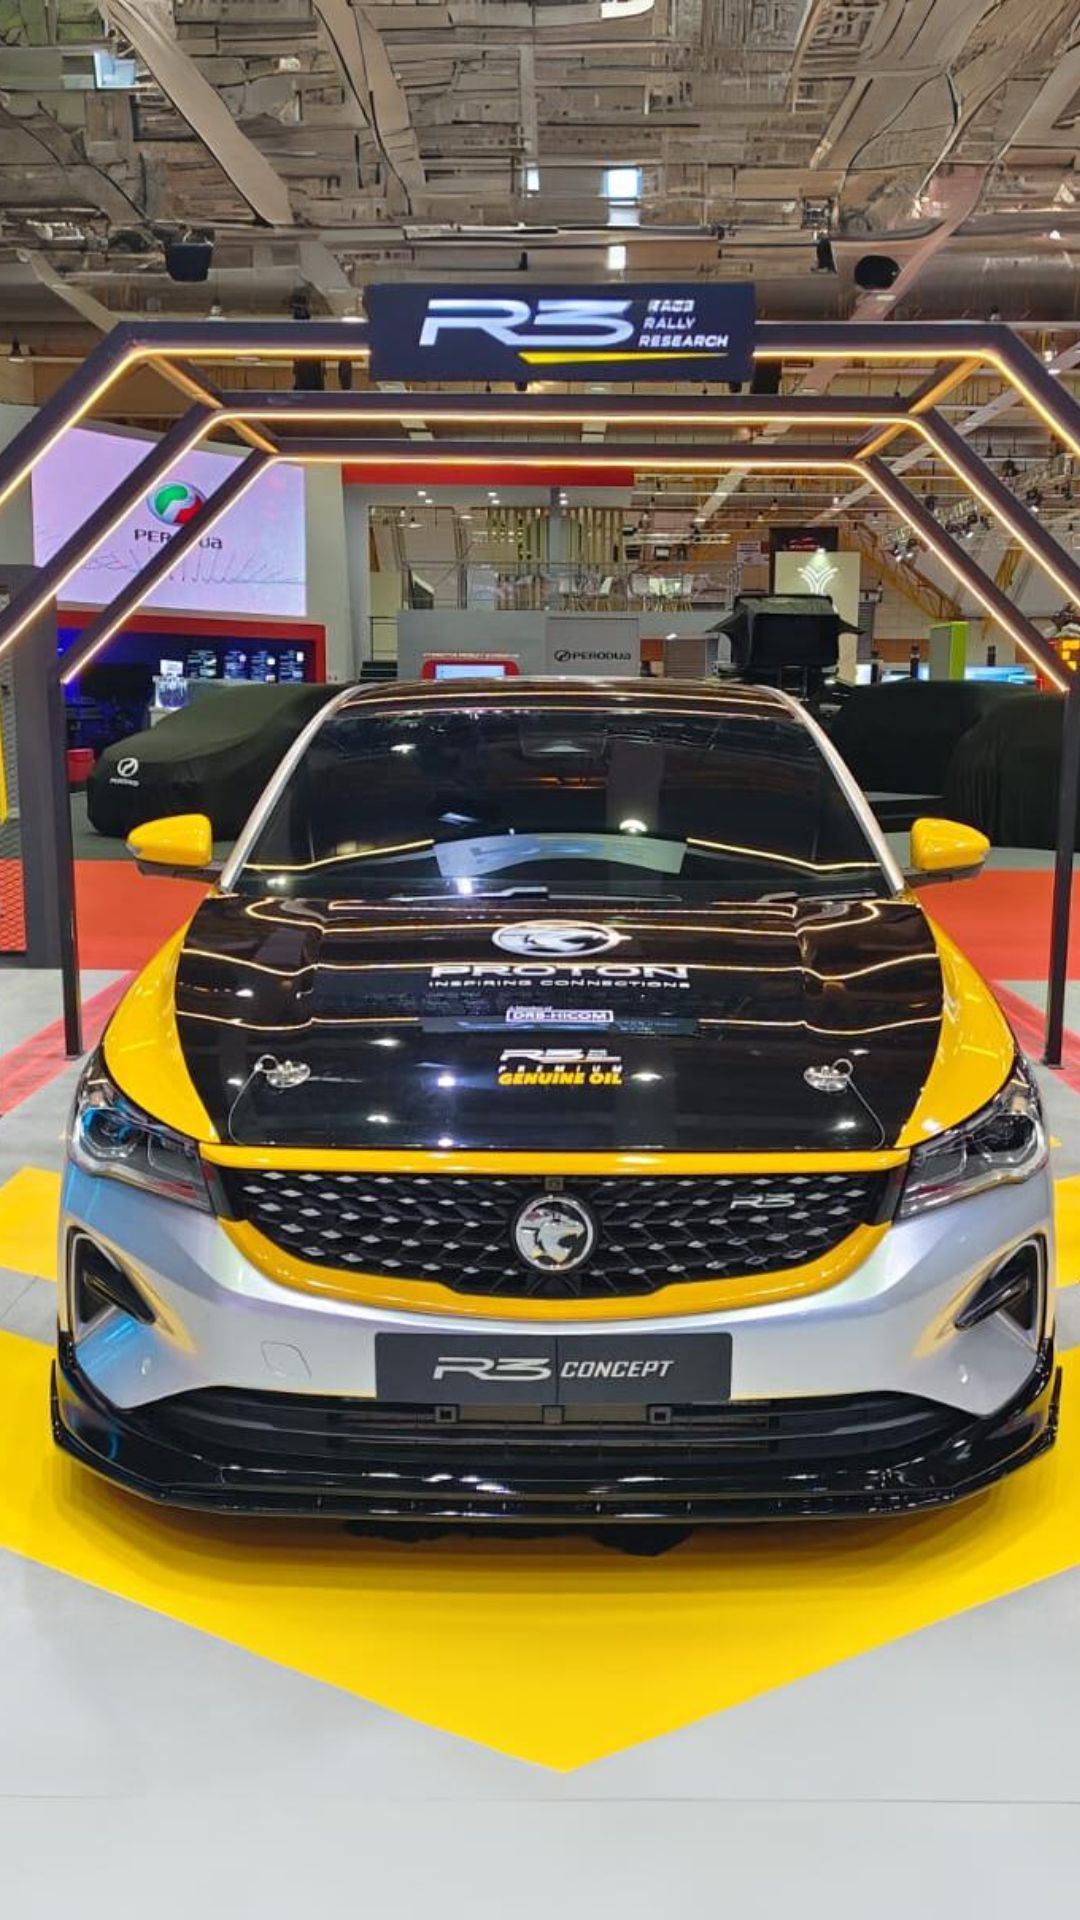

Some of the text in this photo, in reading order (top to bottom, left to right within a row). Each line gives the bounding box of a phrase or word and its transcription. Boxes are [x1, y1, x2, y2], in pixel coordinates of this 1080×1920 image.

[419, 299, 635, 346] R3
[643, 316, 696, 329] RALLY
[638, 334, 729, 347] RESEARCH
[430, 964, 690, 979] PROTON
[428, 979, 691, 988] INSPIRING CONNECTIONS
[498, 1072, 622, 1085] GENUINE OIL
[730, 1193, 795, 1209] R3
[433, 1357, 674, 1381] R3 CONCEPT
